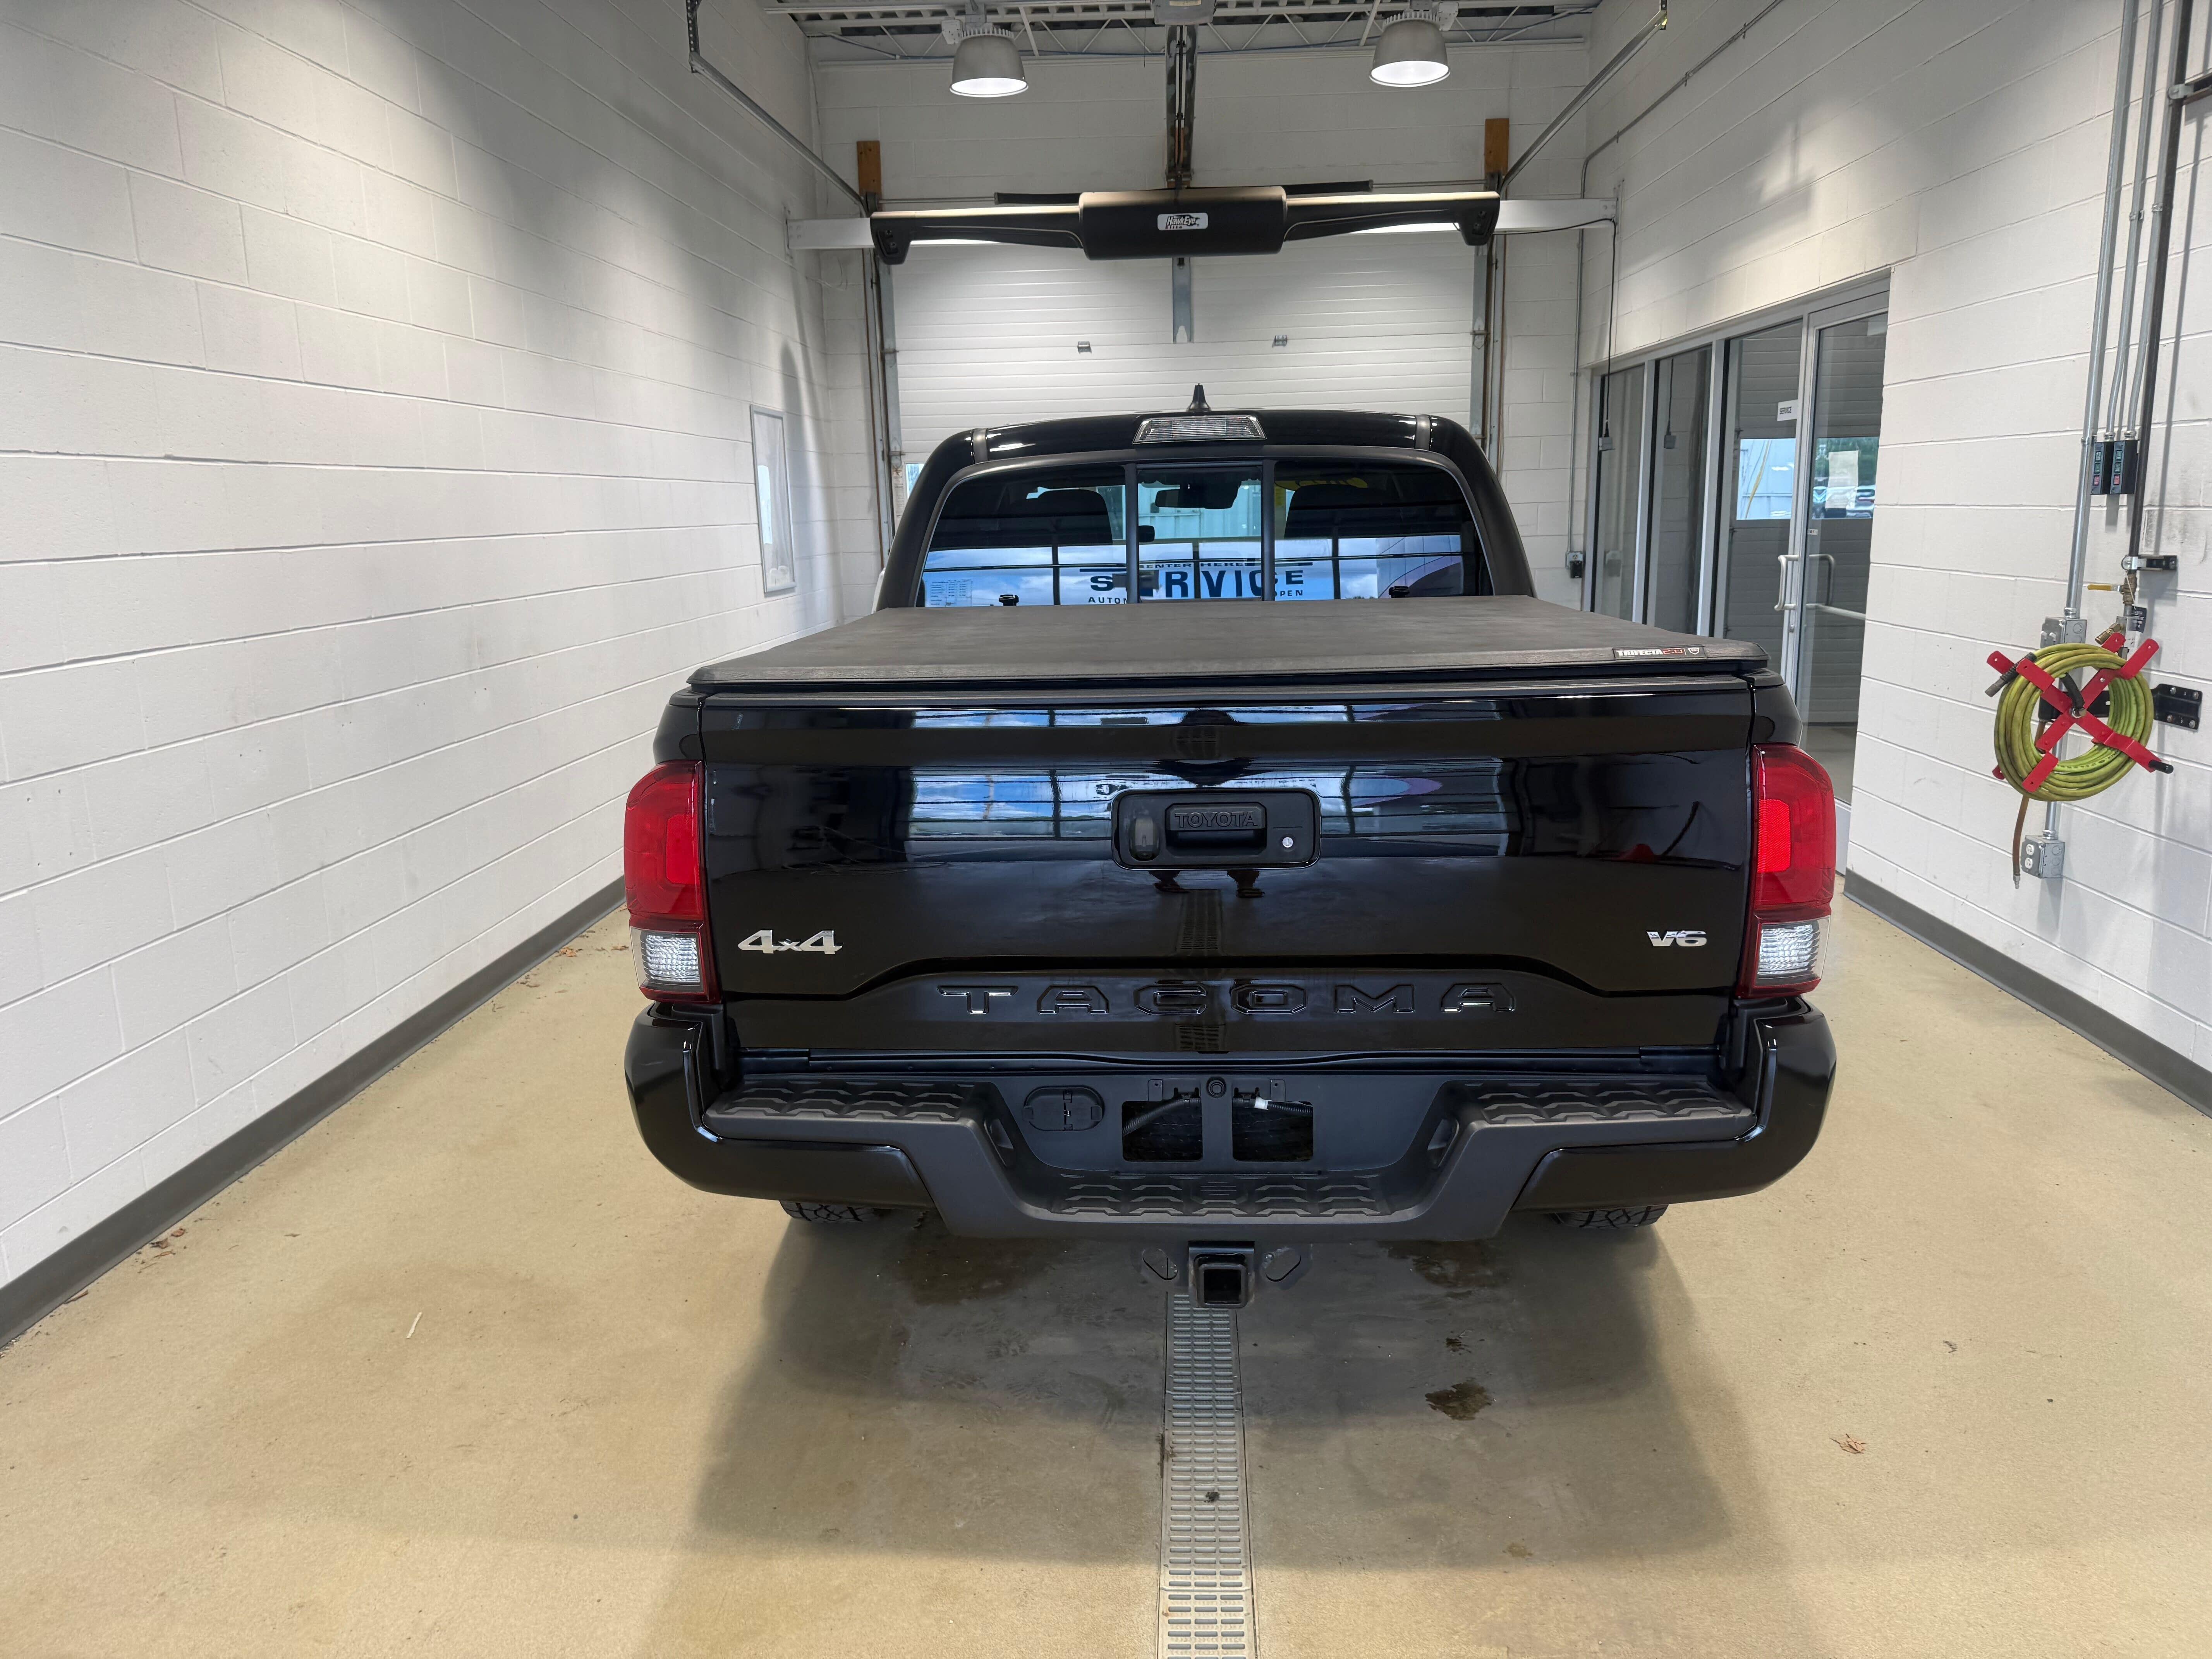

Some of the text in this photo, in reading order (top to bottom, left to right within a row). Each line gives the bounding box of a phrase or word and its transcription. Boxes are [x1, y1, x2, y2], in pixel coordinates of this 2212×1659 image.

[1166, 216, 1196, 225] HawkEye
[1090, 570, 1304, 598] SRVICE
[1175, 811, 1258, 828] TOYOTA
[738, 929, 842, 954] 4x4
[1646, 931, 1707, 946] V6
[937, 983, 1515, 1014] TACOMA
